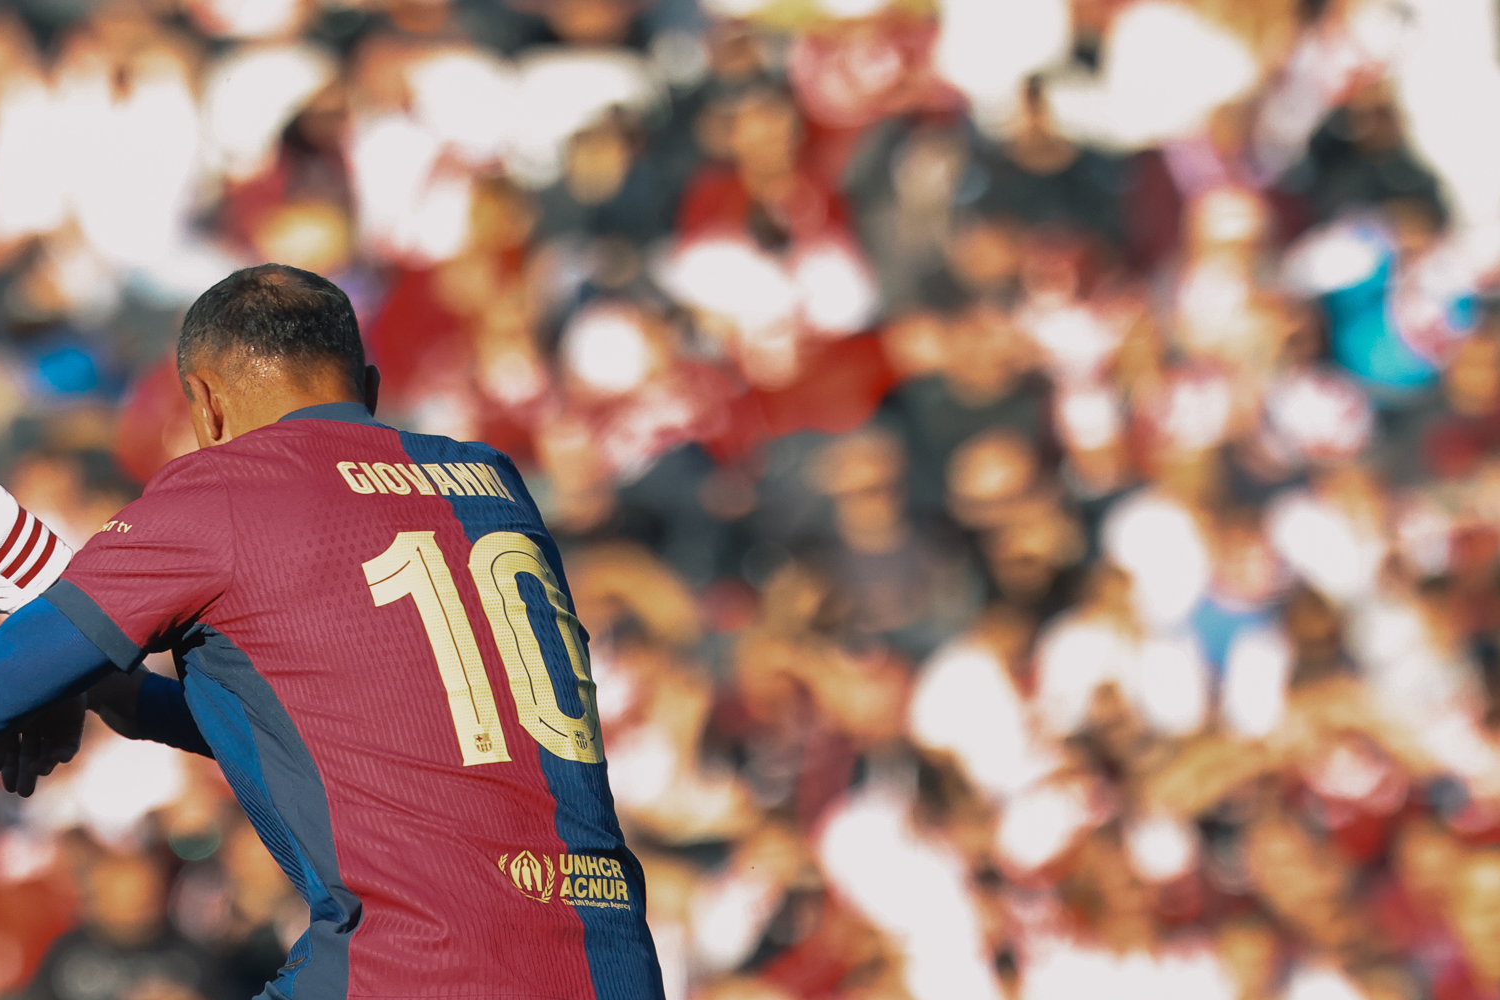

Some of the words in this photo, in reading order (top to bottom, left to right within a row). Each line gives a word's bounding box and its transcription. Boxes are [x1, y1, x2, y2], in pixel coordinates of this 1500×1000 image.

[336, 461, 516, 502] GIOVANNI
[361, 531, 604, 767] 10
[559, 853, 625, 879] UNHCR
[559, 877, 629, 901] ACNUR
